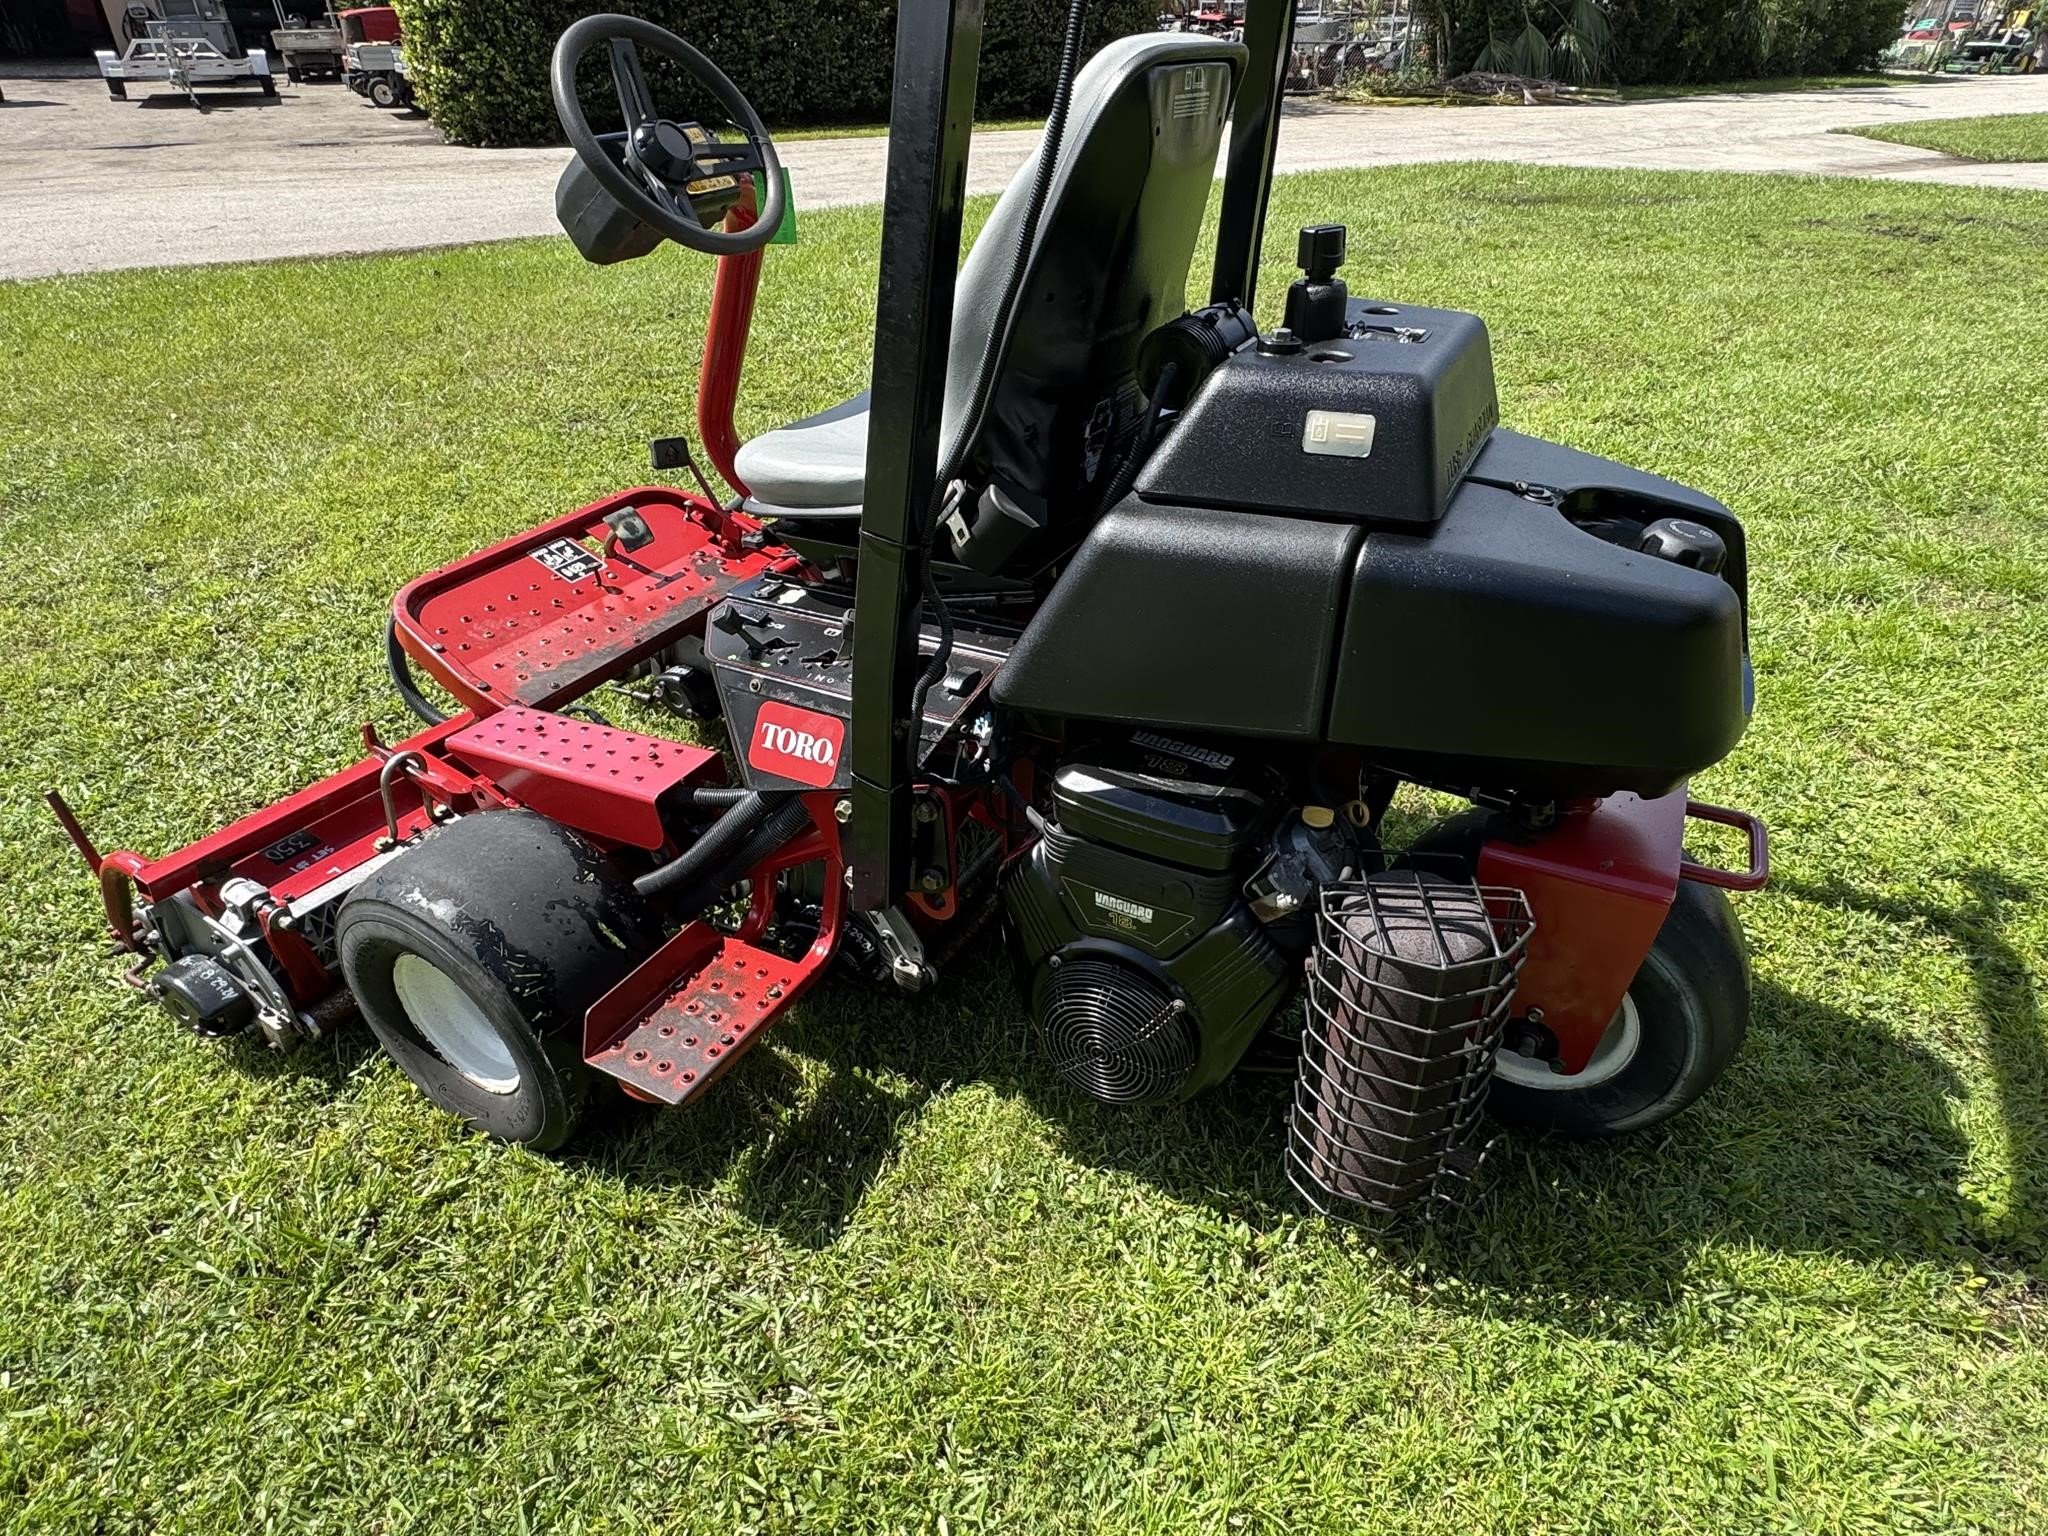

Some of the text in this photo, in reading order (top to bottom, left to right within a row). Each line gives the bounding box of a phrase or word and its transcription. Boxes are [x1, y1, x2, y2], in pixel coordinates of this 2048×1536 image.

[761, 721, 834, 767] TORO
[1130, 731, 1234, 766] VANGUARD
[1094, 891, 1154, 920] VANGUARD
